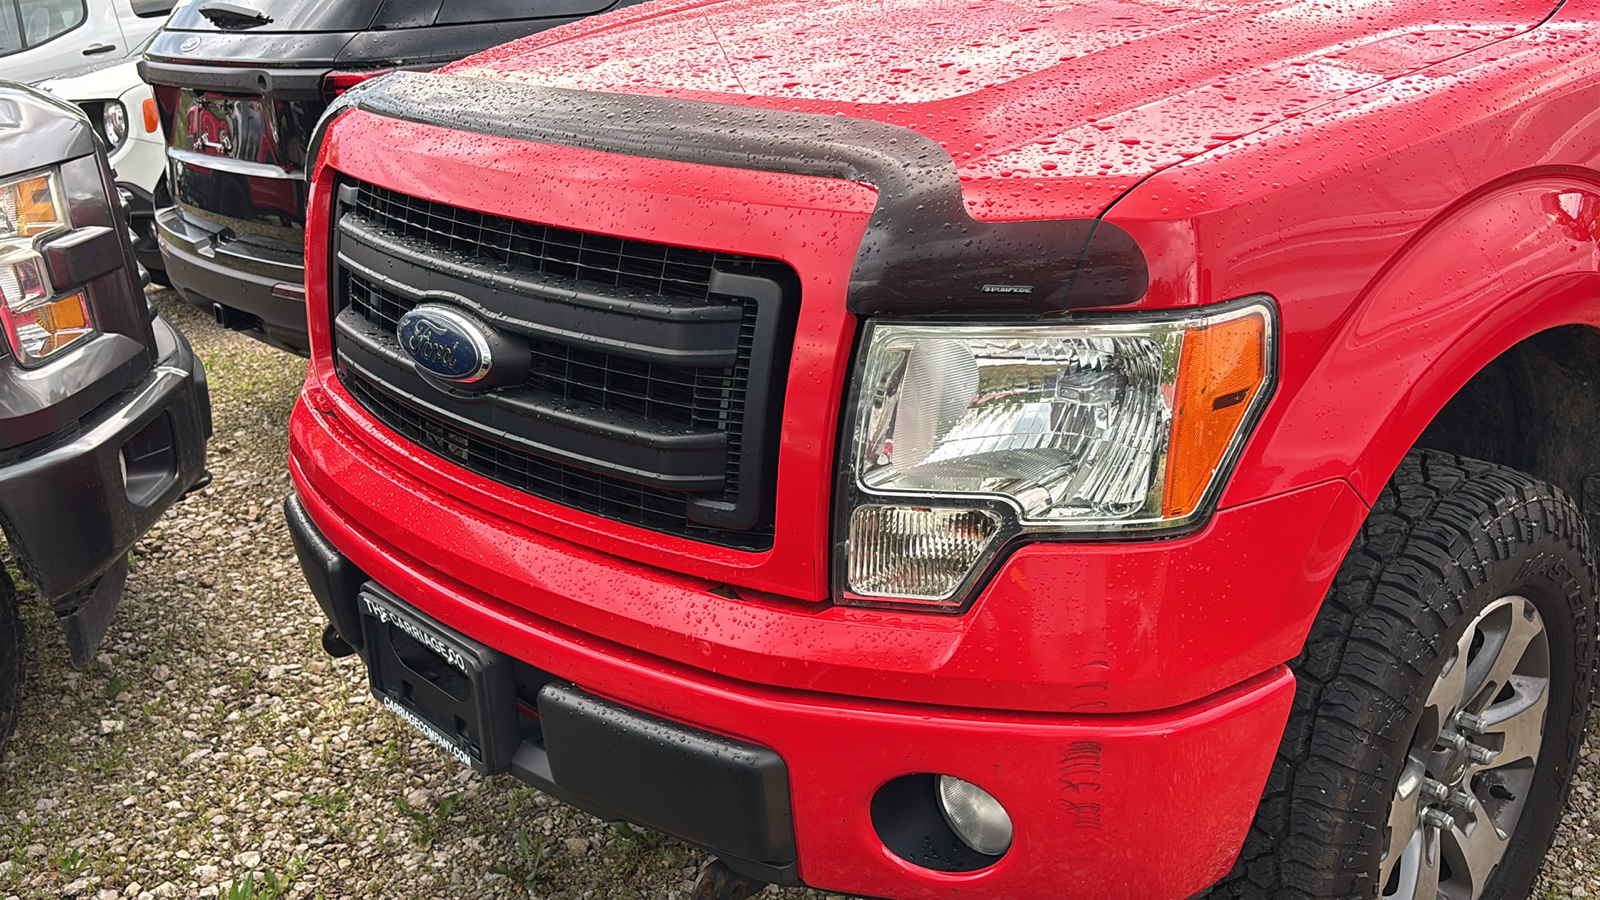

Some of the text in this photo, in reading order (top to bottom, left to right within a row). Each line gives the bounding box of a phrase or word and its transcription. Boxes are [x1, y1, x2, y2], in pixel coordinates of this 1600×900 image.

[983, 285, 1033, 294] STAMPEDE
[408, 319, 460, 373] Ford
[363, 597, 390, 622] THE
[389, 612, 448, 658] CARRIAGE
[383, 696, 472, 767] CARRIAGECOMPANY.COM
